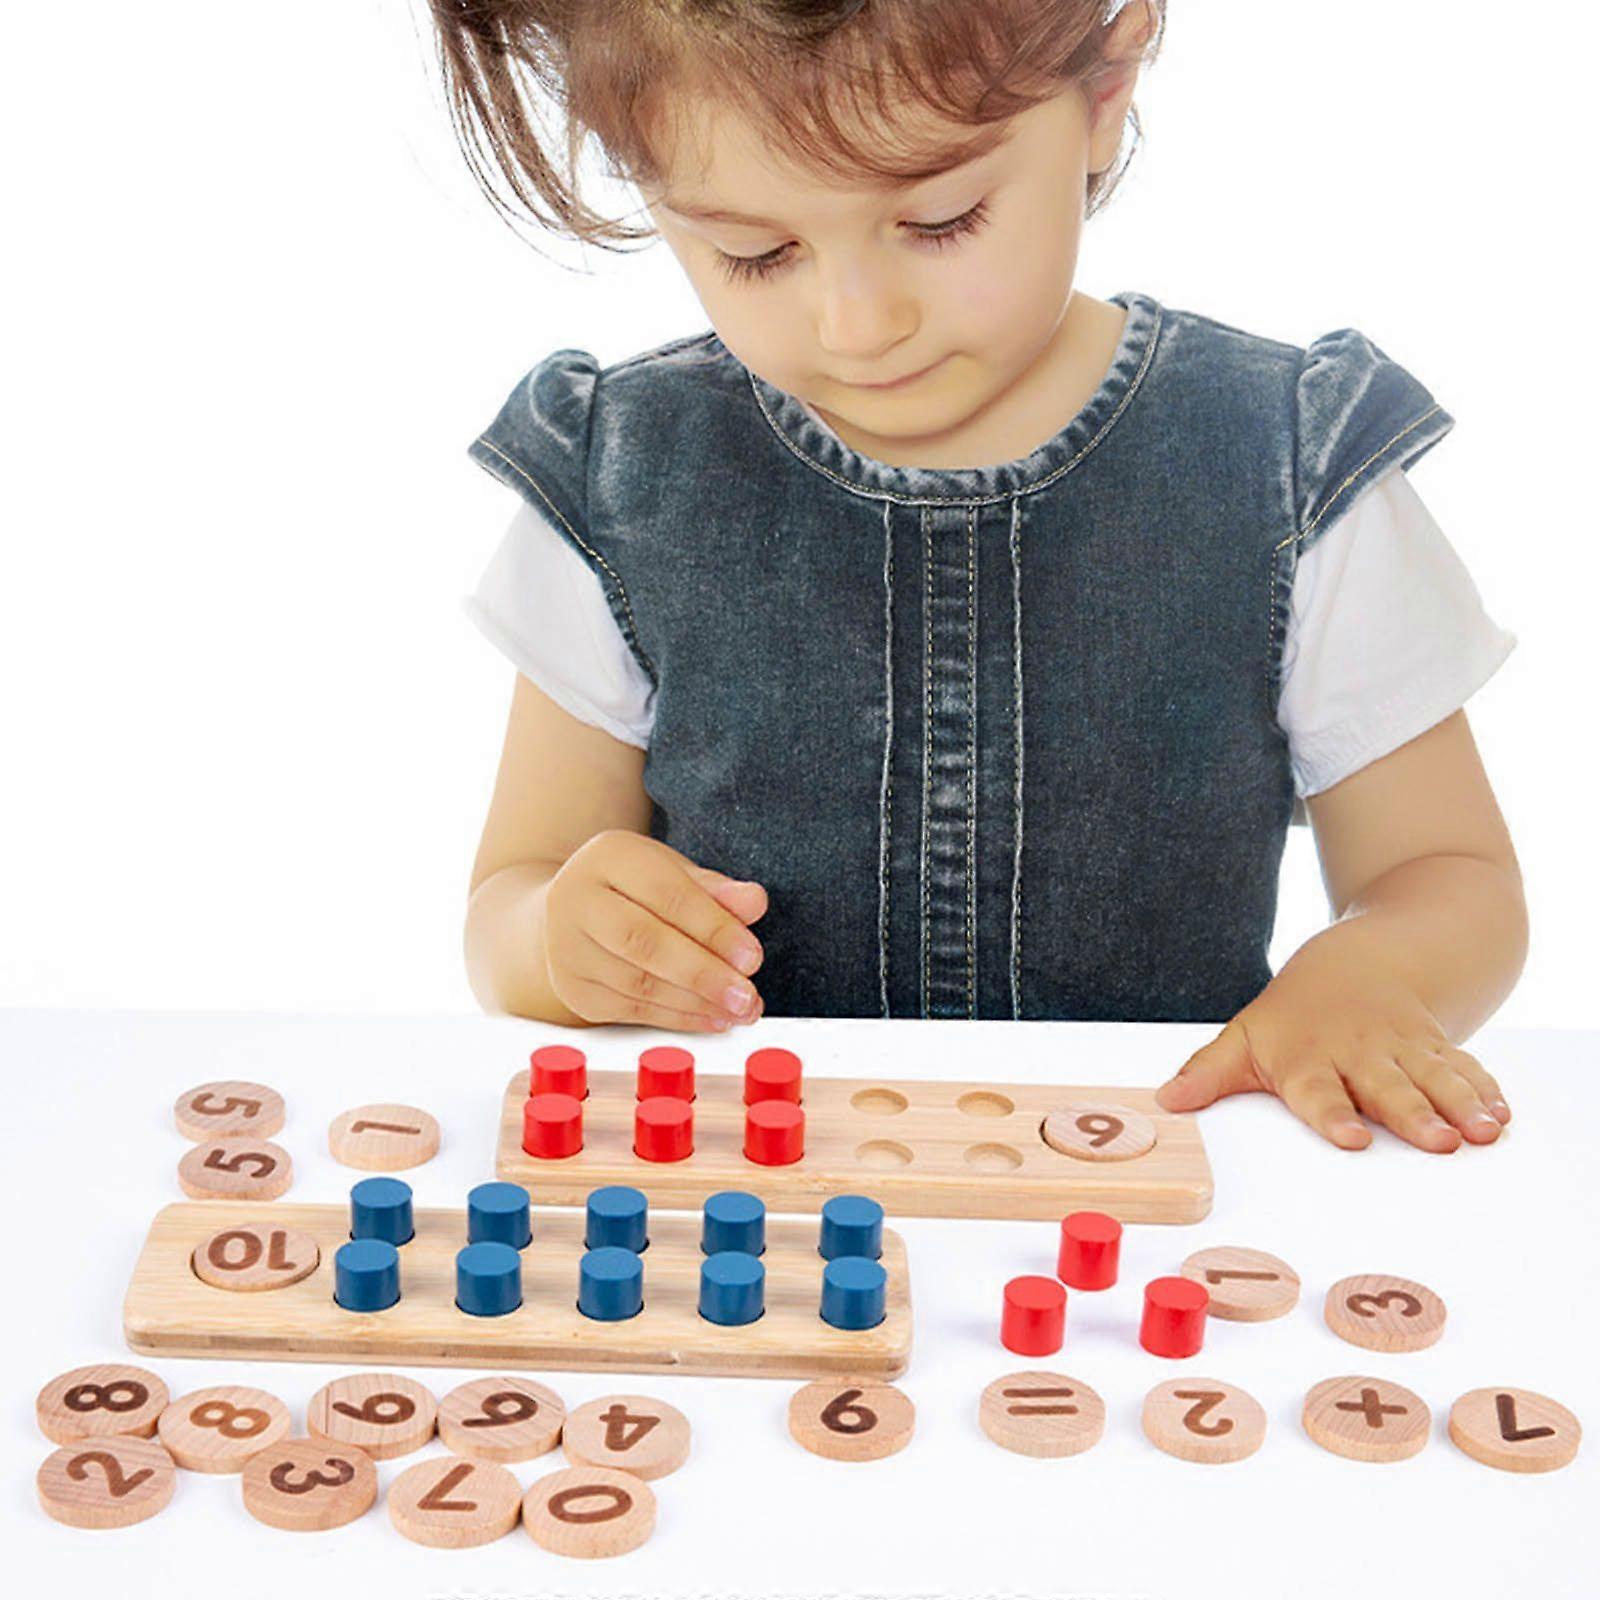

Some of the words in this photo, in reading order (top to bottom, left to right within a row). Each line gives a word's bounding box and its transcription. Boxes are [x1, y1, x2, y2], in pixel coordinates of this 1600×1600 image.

[190, 1092, 262, 1119] 5
[351, 1120, 421, 1134] 1
[203, 1149, 277, 1178] 5
[1346, 1289, 1423, 1318] 3
[63, 1380, 149, 1413] 8
[1173, 1390, 1234, 1437] 2
[189, 1400, 272, 1439] 8
[599, 1404, 661, 1452] 4
[66, 1451, 155, 1497] 2
[269, 1458, 355, 1495] 3
[417, 1463, 477, 1512] 7
[547, 1485, 633, 1524] 0
